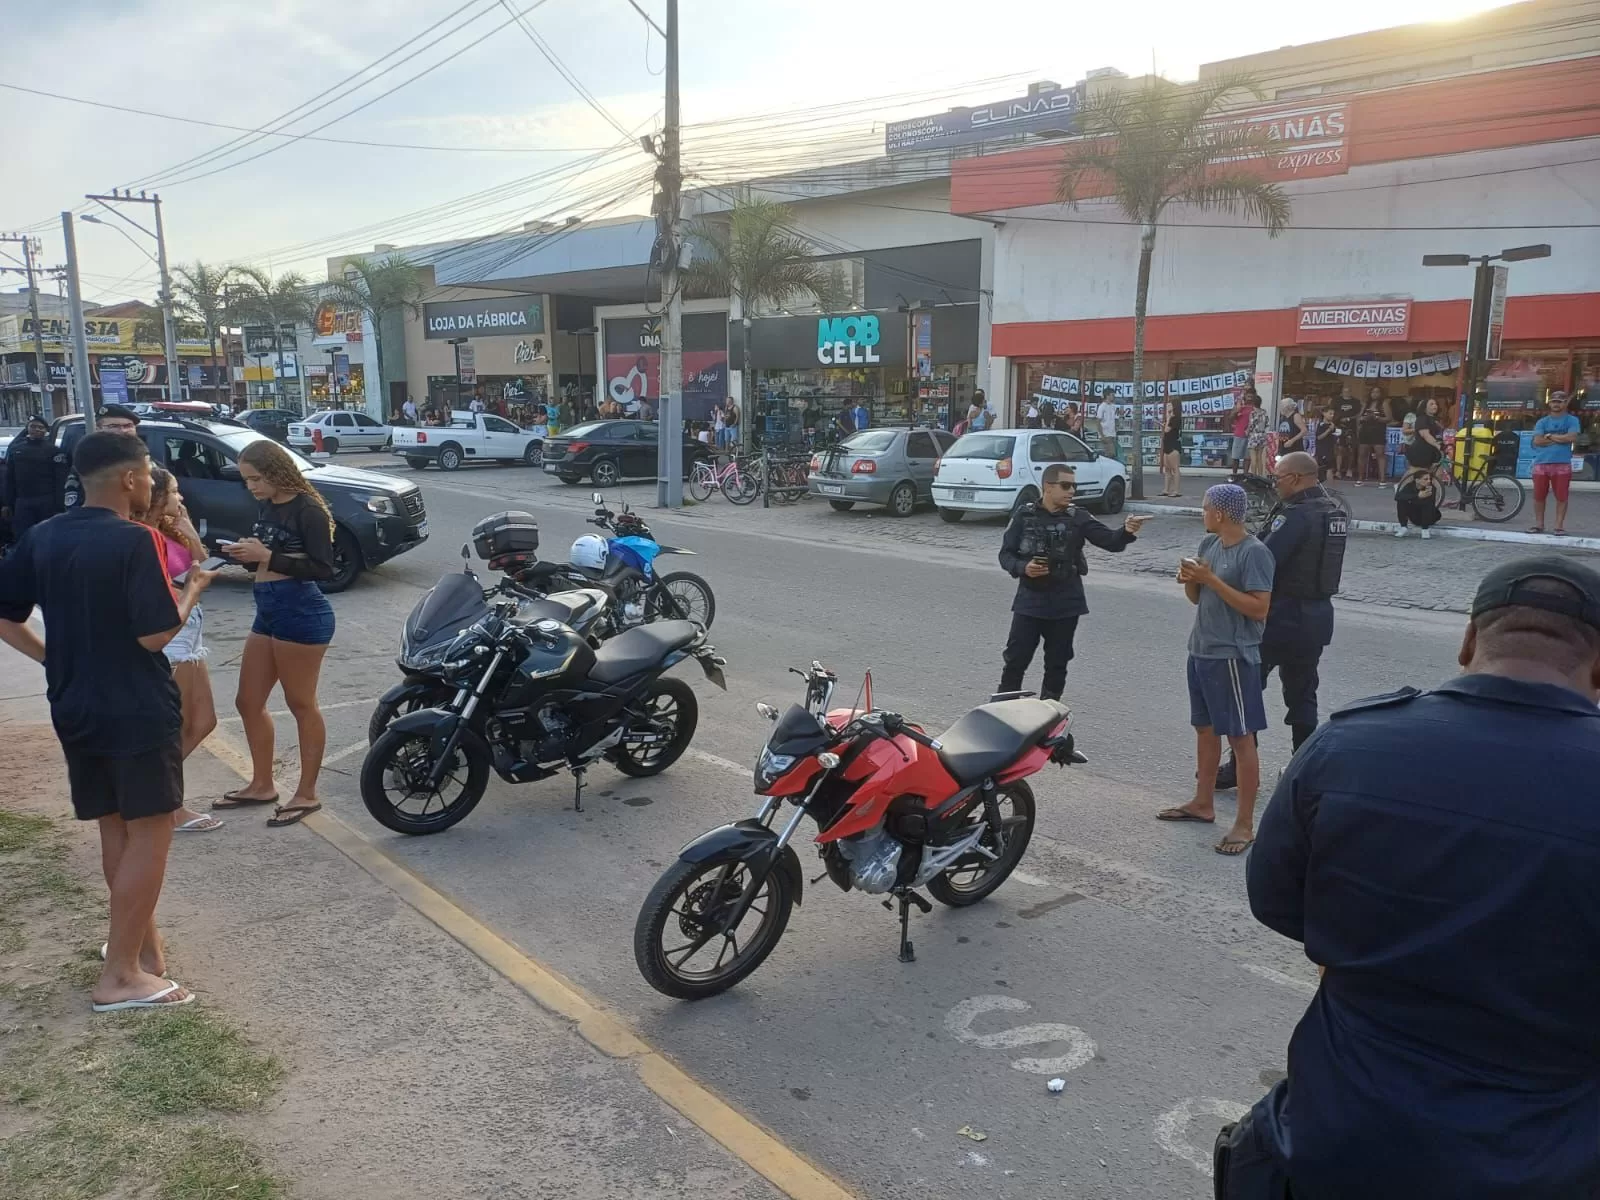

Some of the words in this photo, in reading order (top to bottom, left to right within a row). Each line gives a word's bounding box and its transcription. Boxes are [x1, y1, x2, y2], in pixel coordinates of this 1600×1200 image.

[888, 125, 944, 141] COLONOSCOPIA
[1277, 149, 1342, 174] express
[429, 315, 456, 331] LOJA
[458, 315, 475, 329] DA
[476, 310, 527, 328] FÁBRICA
[1300, 308, 1406, 325] AMERICANAS
[817, 315, 880, 348] MOB
[1366, 326, 1404, 337] express
[817, 341, 880, 364] CELL
[1043, 378, 1078, 392] FAÇA
[1094, 382, 1154, 393] CRTO
